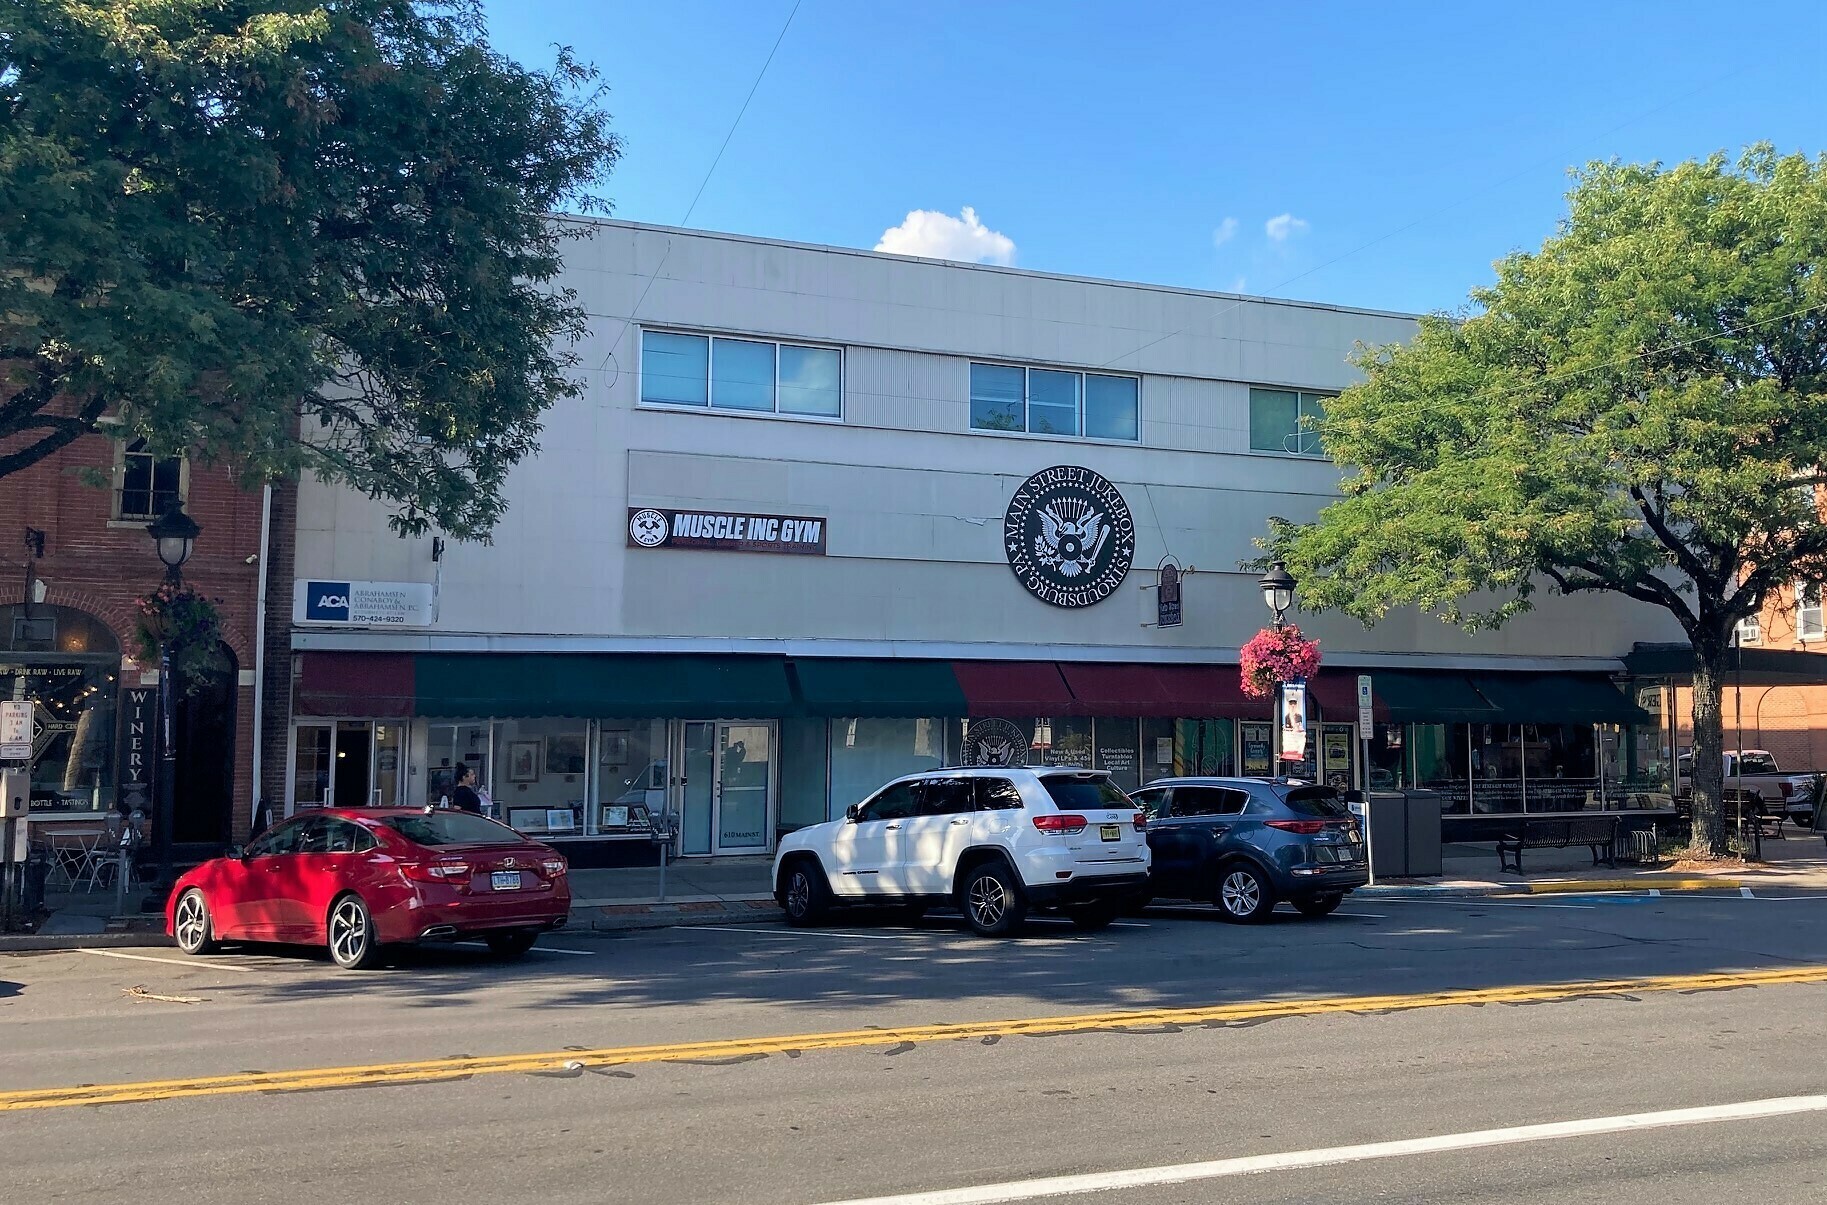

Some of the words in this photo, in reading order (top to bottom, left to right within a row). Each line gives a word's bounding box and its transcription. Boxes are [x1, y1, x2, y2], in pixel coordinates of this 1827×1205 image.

[1006, 489, 1031, 539] MAIN
[1029, 467, 1088, 492] STREET
[1086, 474, 1134, 545] JUKEBOX
[637, 512, 663, 523] MUSCLE
[672, 514, 745, 539] MUSCLE
[747, 518, 778, 541] INC
[781, 519, 821, 543] GYM
[1011, 553, 1029, 577] PA
[318, 595, 349, 608] ACA
[354, 603, 406, 611] ABRAHAMSEN
[353, 615, 405, 623] 570-424-9320
[15, 668, 31, 676] DRINK
[33, 668, 48, 676] RAW
[53, 668, 66, 676] LIVE
[67, 668, 83, 676] RAW
[129, 690, 147, 781] WINERY
[30, 799, 53, 807] BOTTLE
